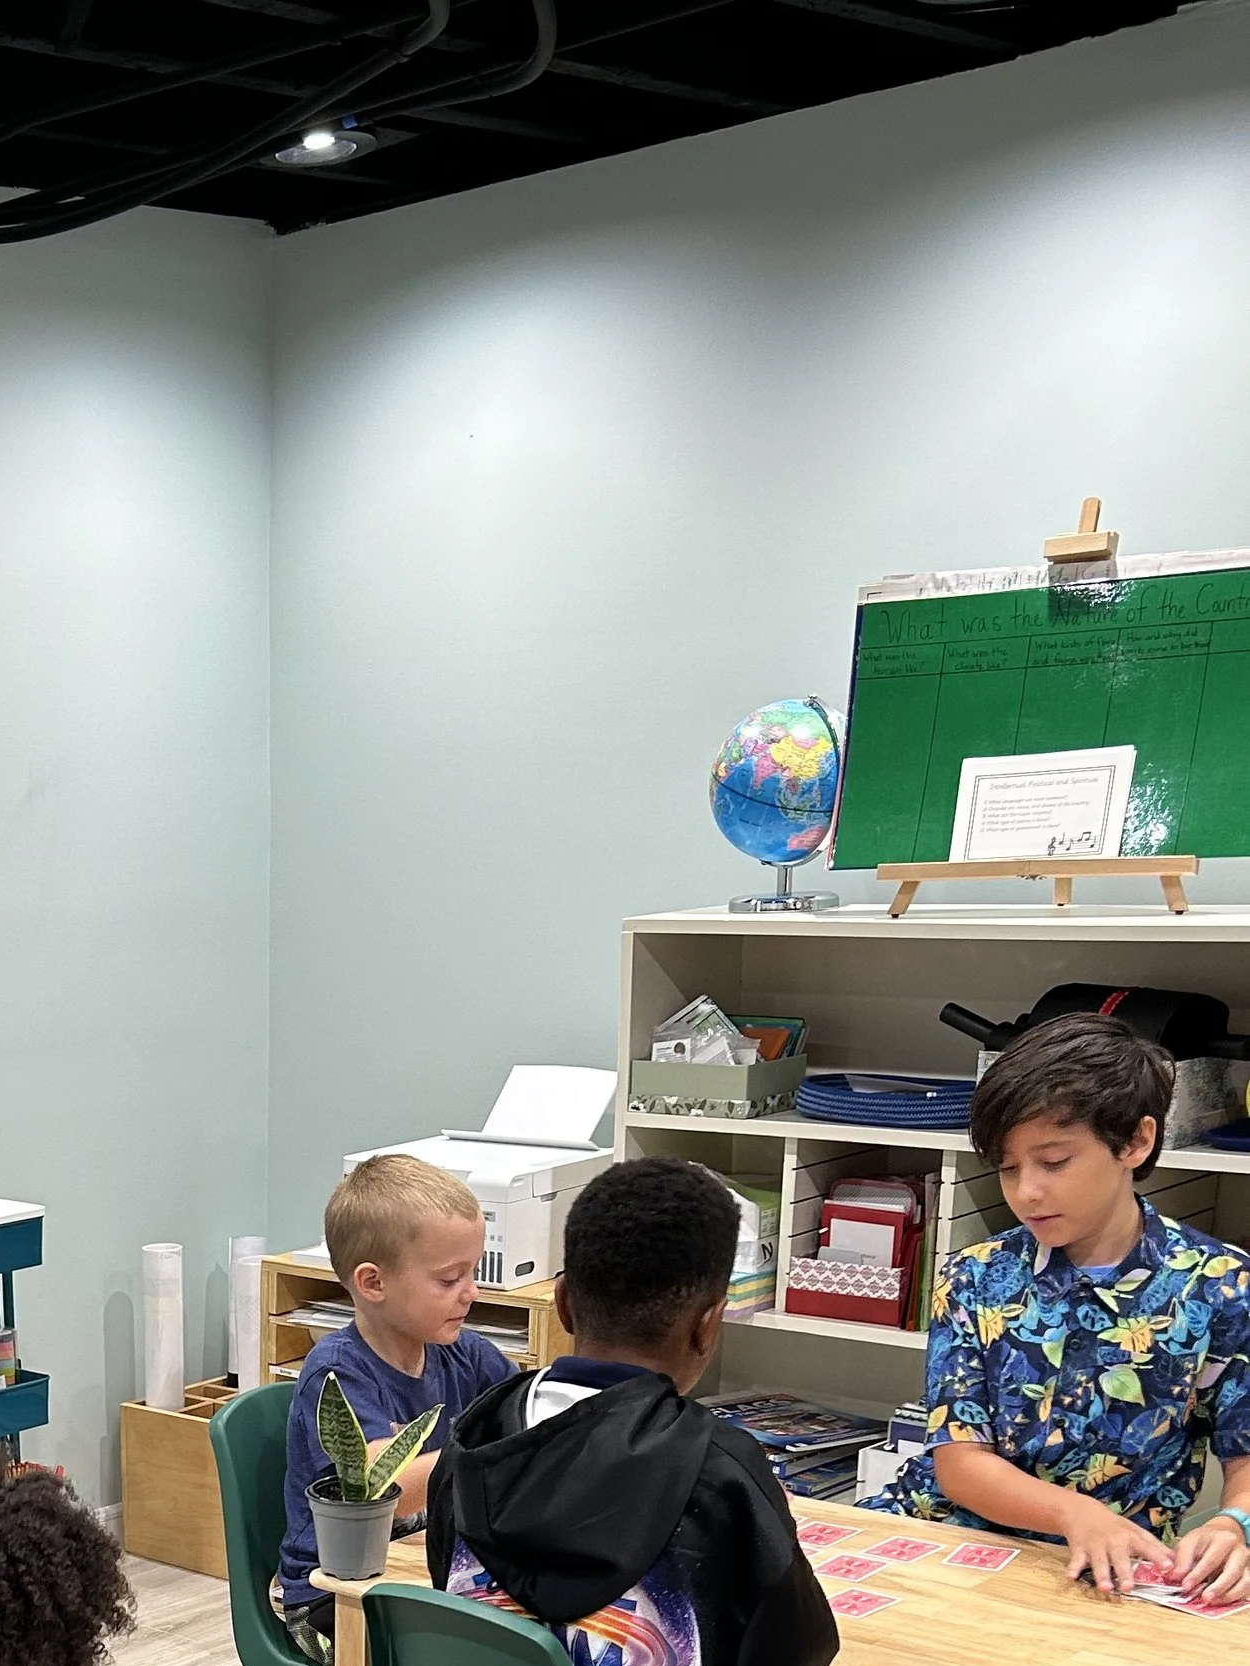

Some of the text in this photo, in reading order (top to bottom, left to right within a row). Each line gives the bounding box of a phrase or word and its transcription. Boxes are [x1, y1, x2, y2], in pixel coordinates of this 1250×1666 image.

[880, 583, 1250, 643] What was the Nature of the Countr
